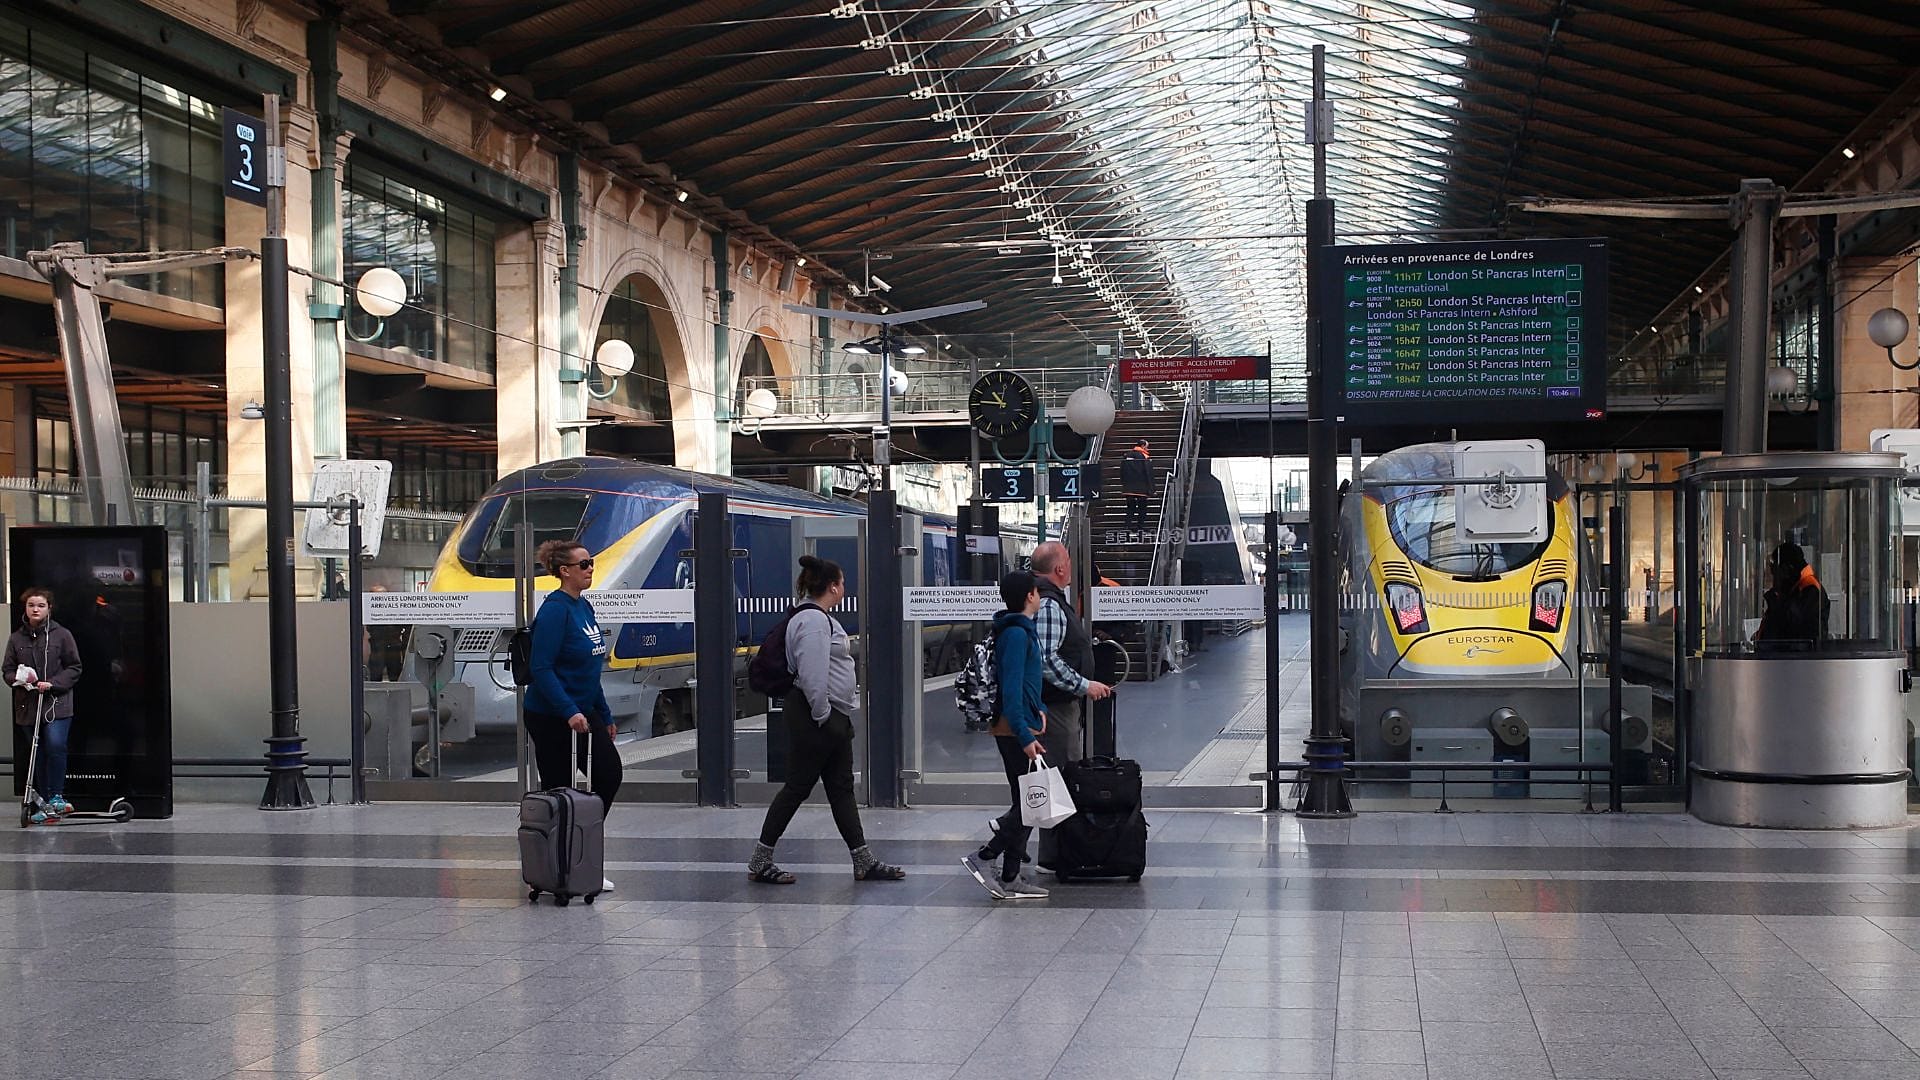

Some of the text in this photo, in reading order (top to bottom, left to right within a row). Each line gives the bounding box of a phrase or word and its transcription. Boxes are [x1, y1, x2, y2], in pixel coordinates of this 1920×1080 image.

[239, 125, 252, 140] Voie
[240, 143, 253, 181] 3
[1344, 254, 1388, 265] Arrivées
[1408, 253, 1470, 264] provenance
[1474, 251, 1487, 260] de
[1490, 250, 1534, 260] Londres
[1394, 267, 1565, 281] 11h17 London St Pancras Intern
[1366, 283, 1449, 294] eet International
[1394, 294, 1565, 308] 12h50 London St Pancras Intern
[1367, 307, 1538, 320] London St Pancras Intern Ashford
[1394, 320, 1552, 332] 13h47 London St Pancras Intern
[1394, 333, 1552, 345] 15h47 London St Pancras Intern
[1394, 346, 1545, 358] 16h47 London St Pancras Inter
[1159, 360, 1183, 368] SURETE
[1394, 359, 1552, 371] 17h47 London St Pancras Intern
[1394, 372, 1545, 384] 18h47 London St Pancras Inter
[1347, 390, 1378, 399] OISSON
[1380, 390, 1420, 398] PERTURBE
[1422, 390, 1431, 398] LA
[1433, 388, 1488, 397] CIRCULATION
[1489, 388, 1505, 396] DES
[1508, 388, 1537, 396] TRAINS
[1006, 478, 1019, 496] 3
[1064, 477, 1078, 495] 4
[1448, 636, 1514, 644] EUROSTAR
